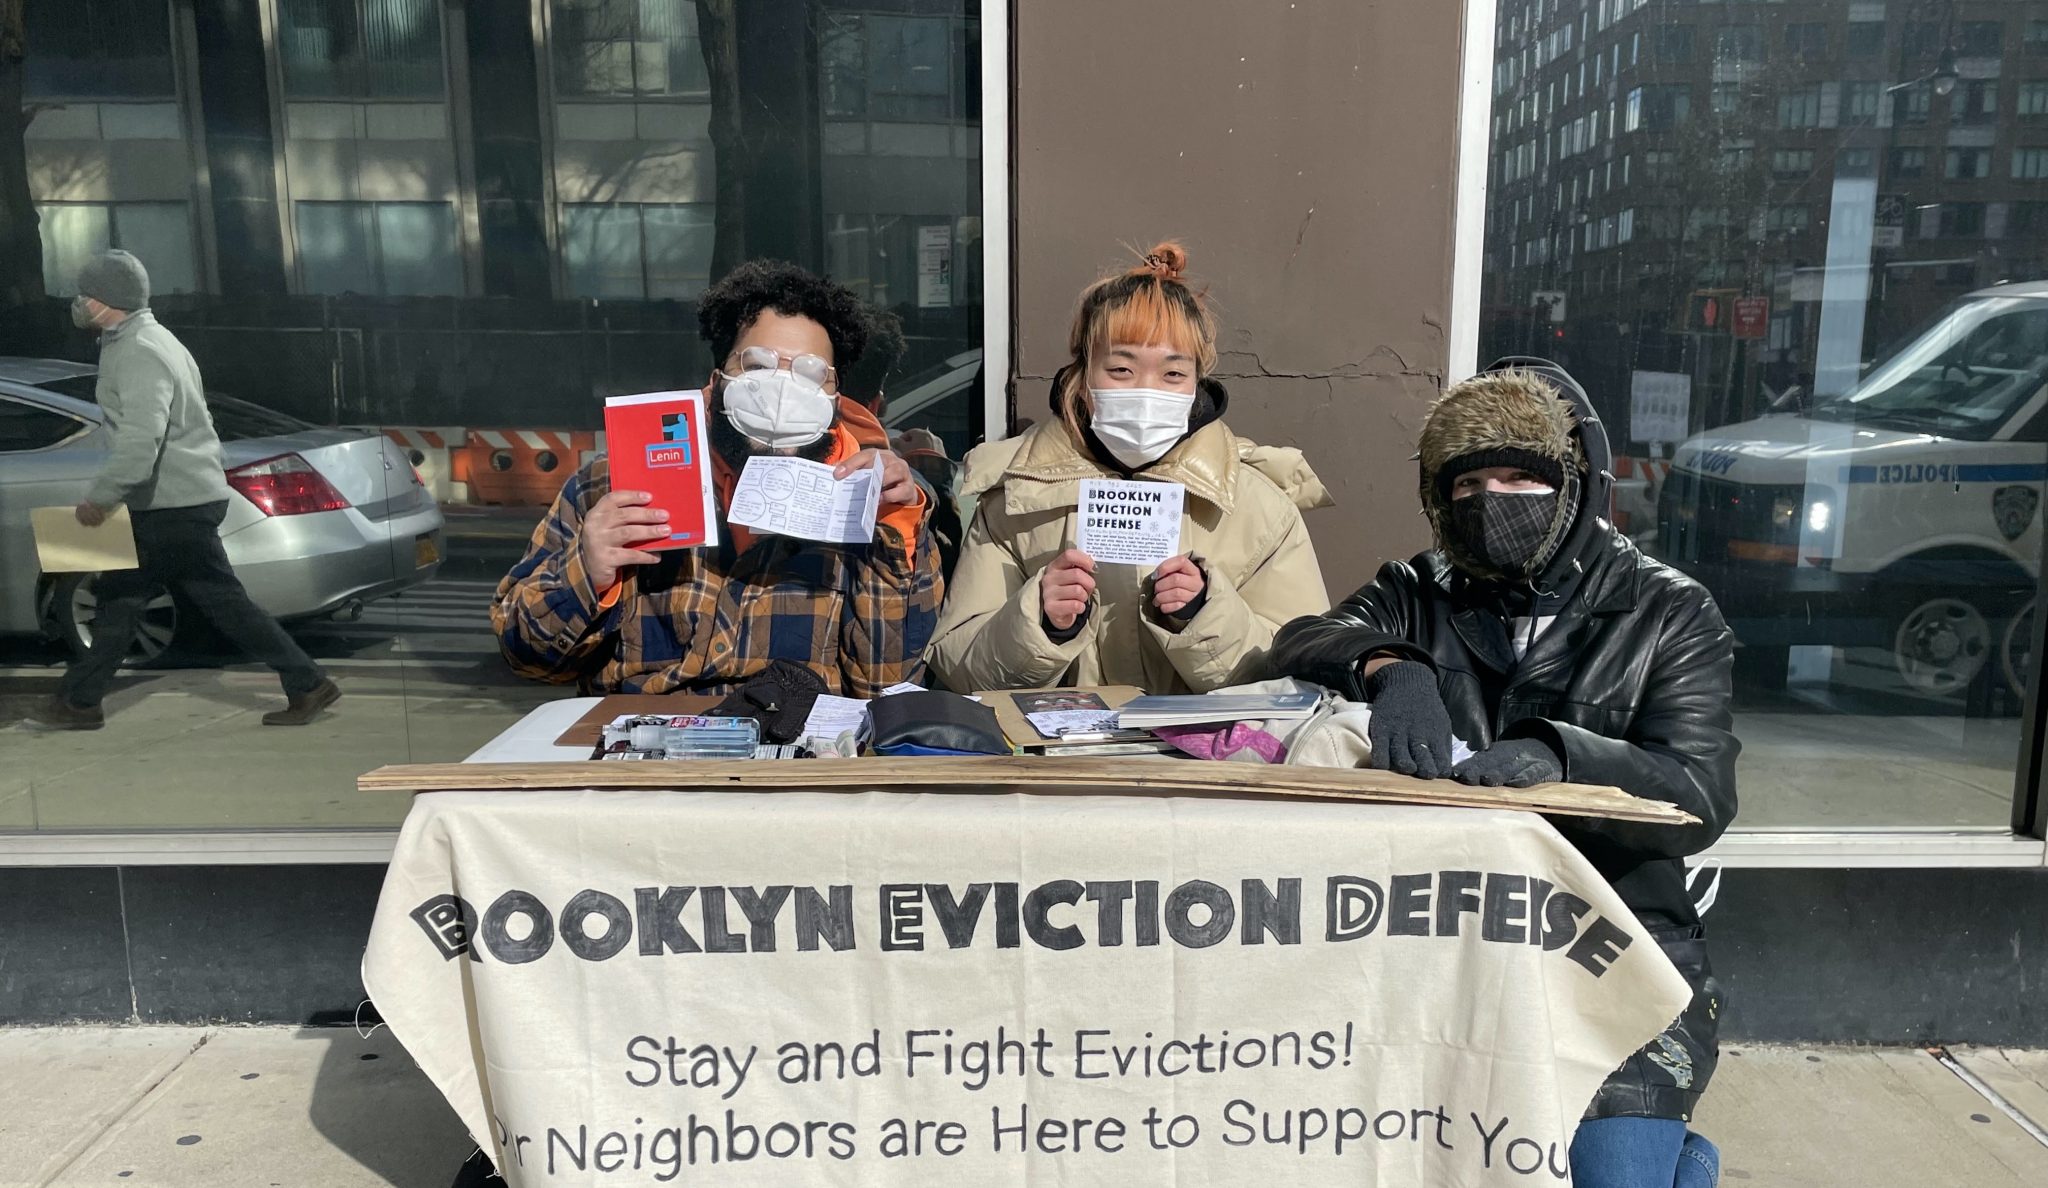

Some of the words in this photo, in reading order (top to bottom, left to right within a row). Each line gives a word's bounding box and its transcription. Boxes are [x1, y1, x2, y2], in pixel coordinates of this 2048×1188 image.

[649, 449, 680, 463] Lenin
[1088, 489, 1161, 502] BROOKLYN
[1088, 503, 1152, 516] EVICTION
[1087, 518, 1142, 530] DEFENSE
[880, 878, 1302, 952] EVICTION
[625, 1036, 758, 1100] Stay
[777, 1028, 882, 1085] and
[906, 1026, 1055, 1090] Fight
[1075, 1022, 1353, 1079] Evictions!
[547, 1109, 857, 1182] Neighbors
[880, 1119, 967, 1159] are
[992, 1102, 1127, 1153] Here
[1142, 1106, 1200, 1150] to
[1222, 1099, 1454, 1155] Support
[1470, 1111, 1568, 1180] You
